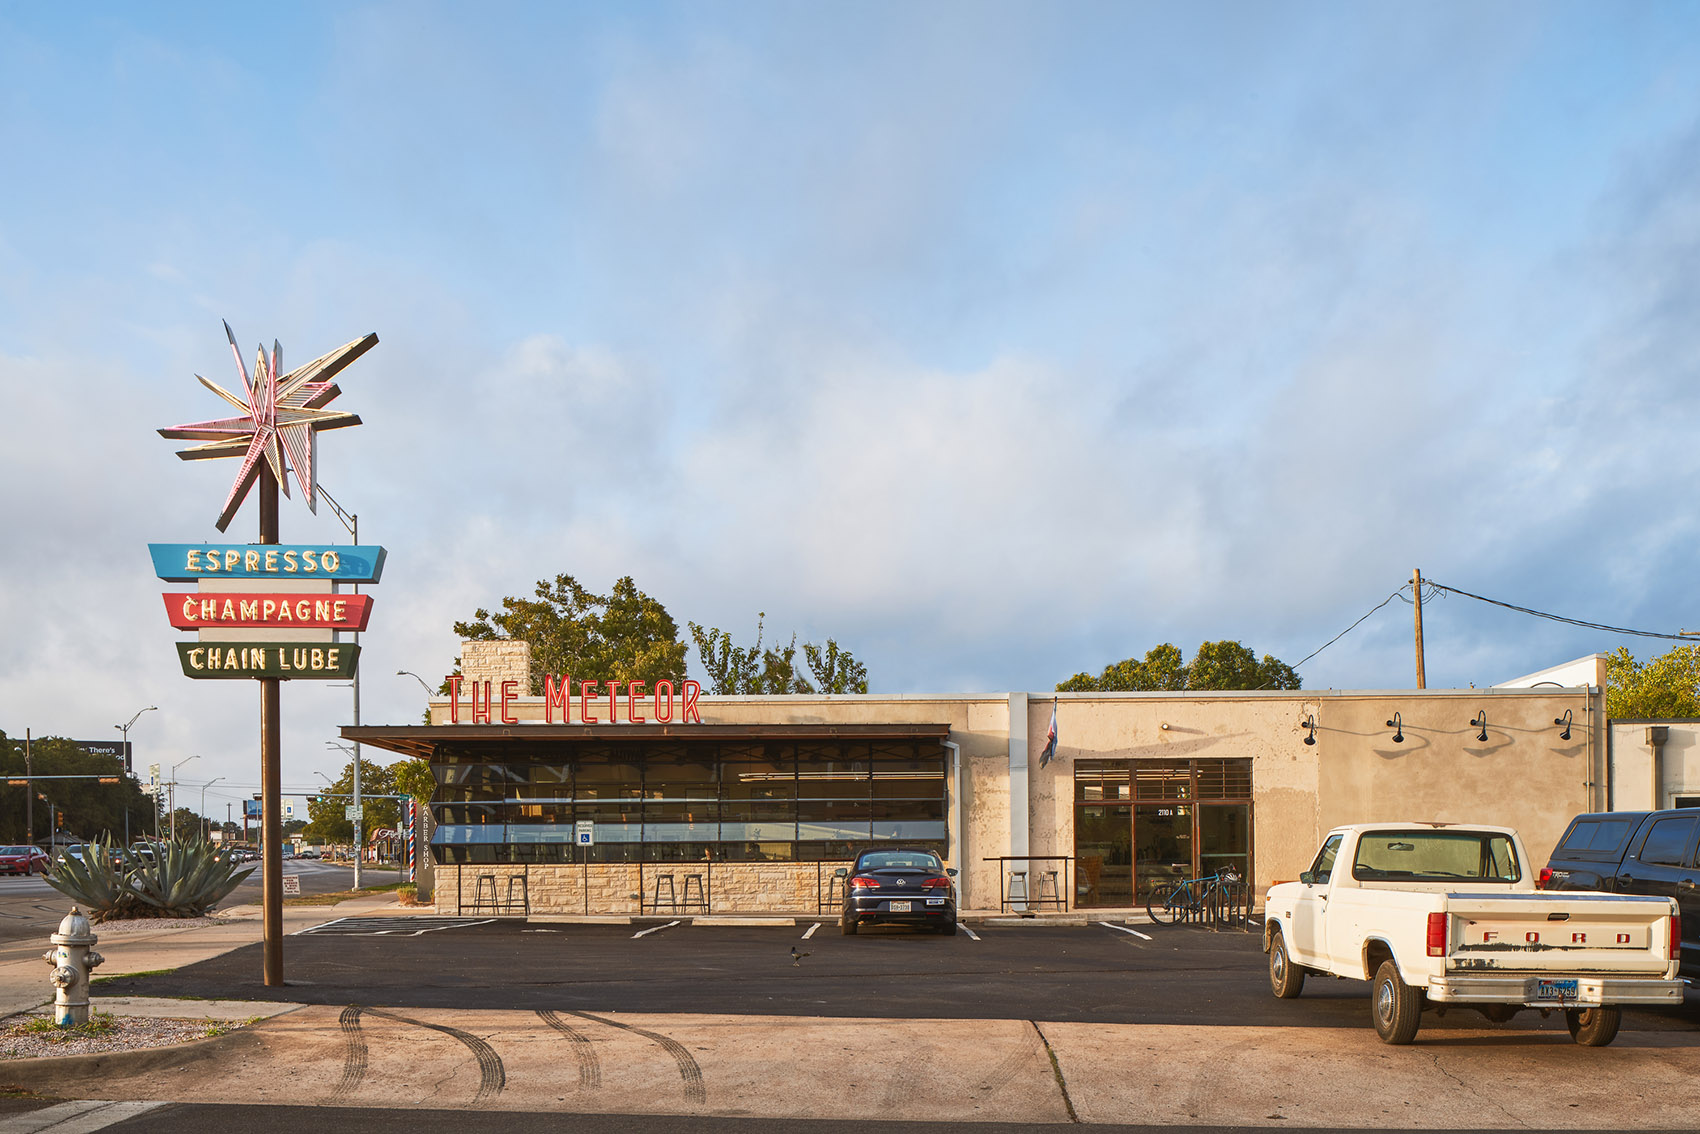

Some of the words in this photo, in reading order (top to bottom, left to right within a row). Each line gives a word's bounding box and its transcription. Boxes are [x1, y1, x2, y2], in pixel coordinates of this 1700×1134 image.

[184, 549, 341, 574] ESPRESSO
[182, 595, 348, 623] CHAMPAGNE
[186, 647, 266, 671] CHAIN
[278, 647, 341, 673] LUBE
[445, 675, 519, 724] THE
[545, 673, 702, 724] METEOR
[88, 746, 116, 754] There's
[1482, 931, 1632, 945] FORD
